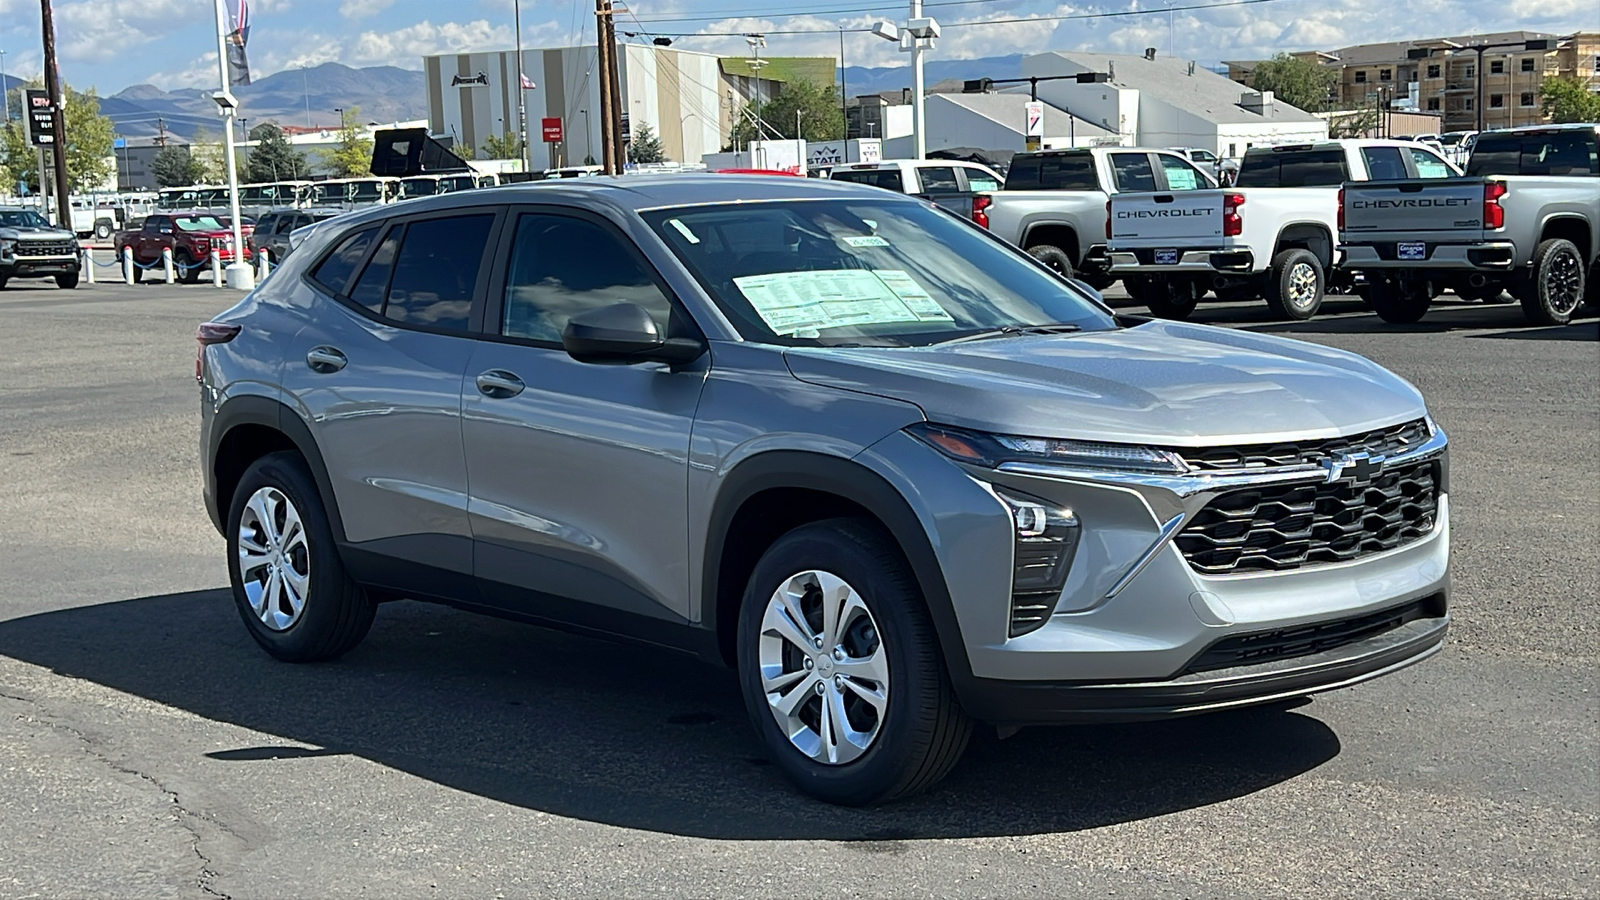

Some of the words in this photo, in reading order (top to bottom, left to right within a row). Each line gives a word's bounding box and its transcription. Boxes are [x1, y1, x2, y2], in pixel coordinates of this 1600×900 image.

[807, 156, 841, 164] STATE
[1353, 198, 1473, 209] CHEVROLET
[1117, 208, 1214, 218] CHEVROLET
